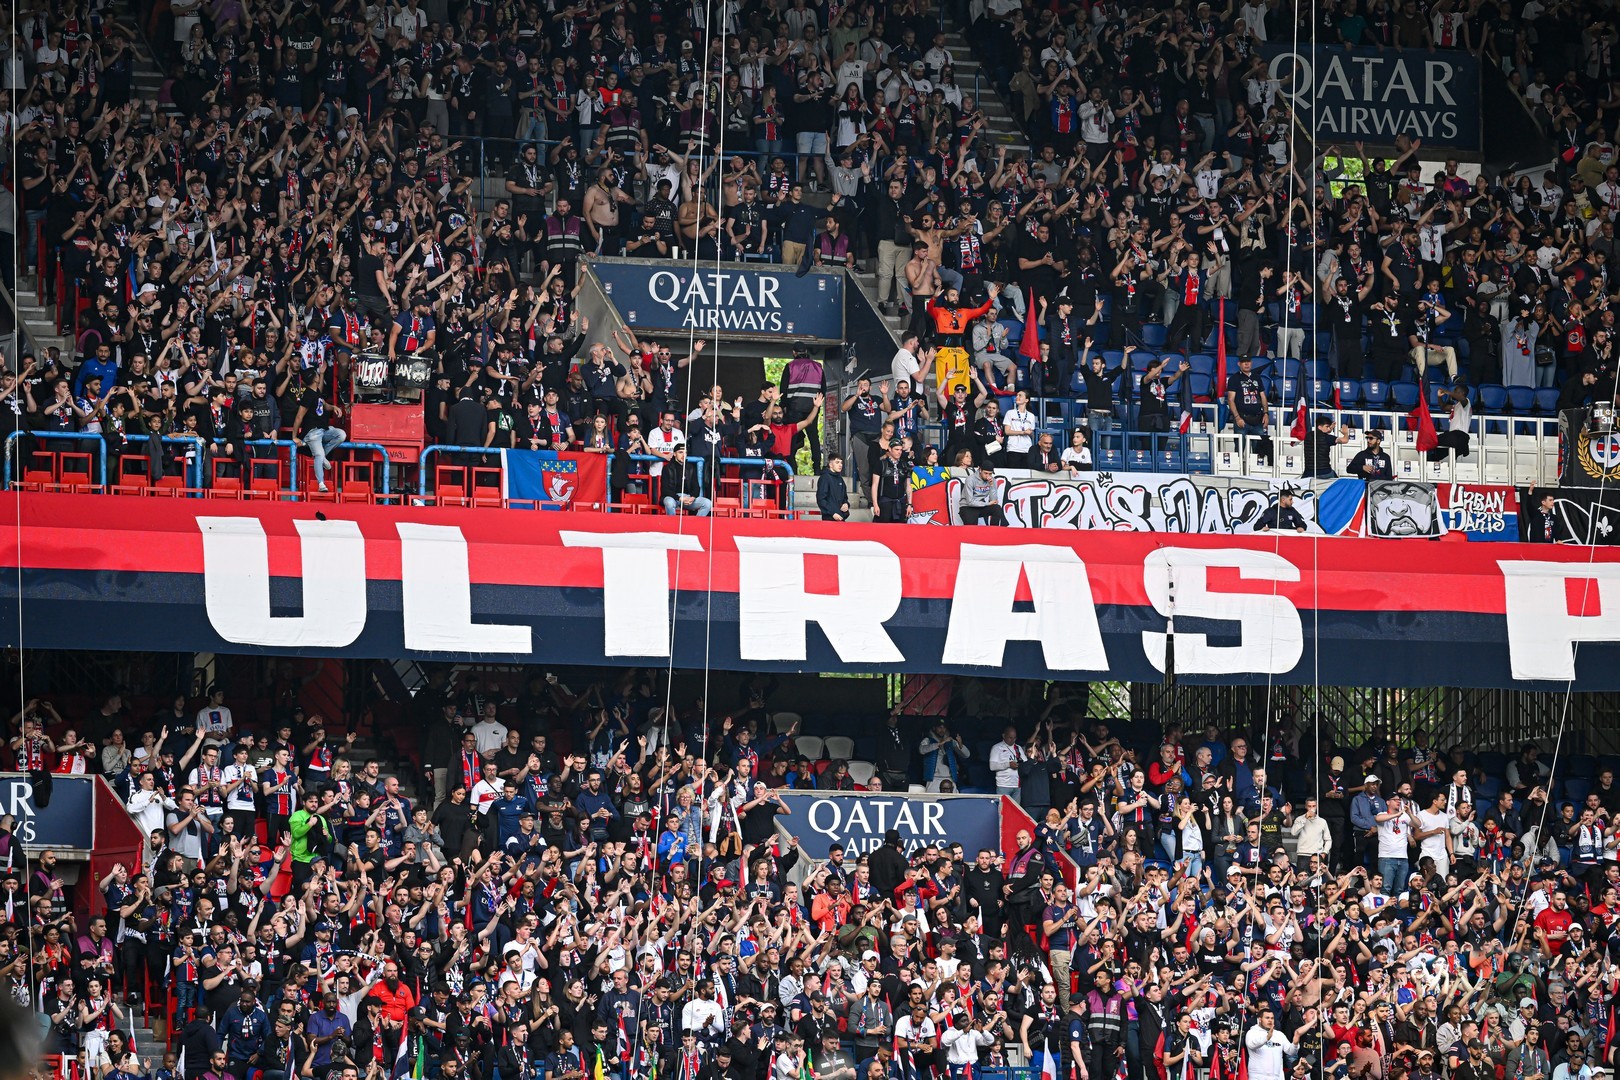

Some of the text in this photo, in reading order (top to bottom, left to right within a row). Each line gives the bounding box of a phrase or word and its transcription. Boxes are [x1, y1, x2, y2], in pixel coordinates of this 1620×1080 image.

[1268, 52, 1457, 110] QATAR
[1316, 105, 1458, 139] AIRWAYS
[648, 271, 782, 312] QATAR
[682, 308, 782, 332] AIRWAYS
[1449, 484, 1506, 514] URBAN
[1449, 508, 1505, 533] PARIS
[196, 516, 1304, 674] ULTRAS
[808, 799, 947, 842] QATAR
